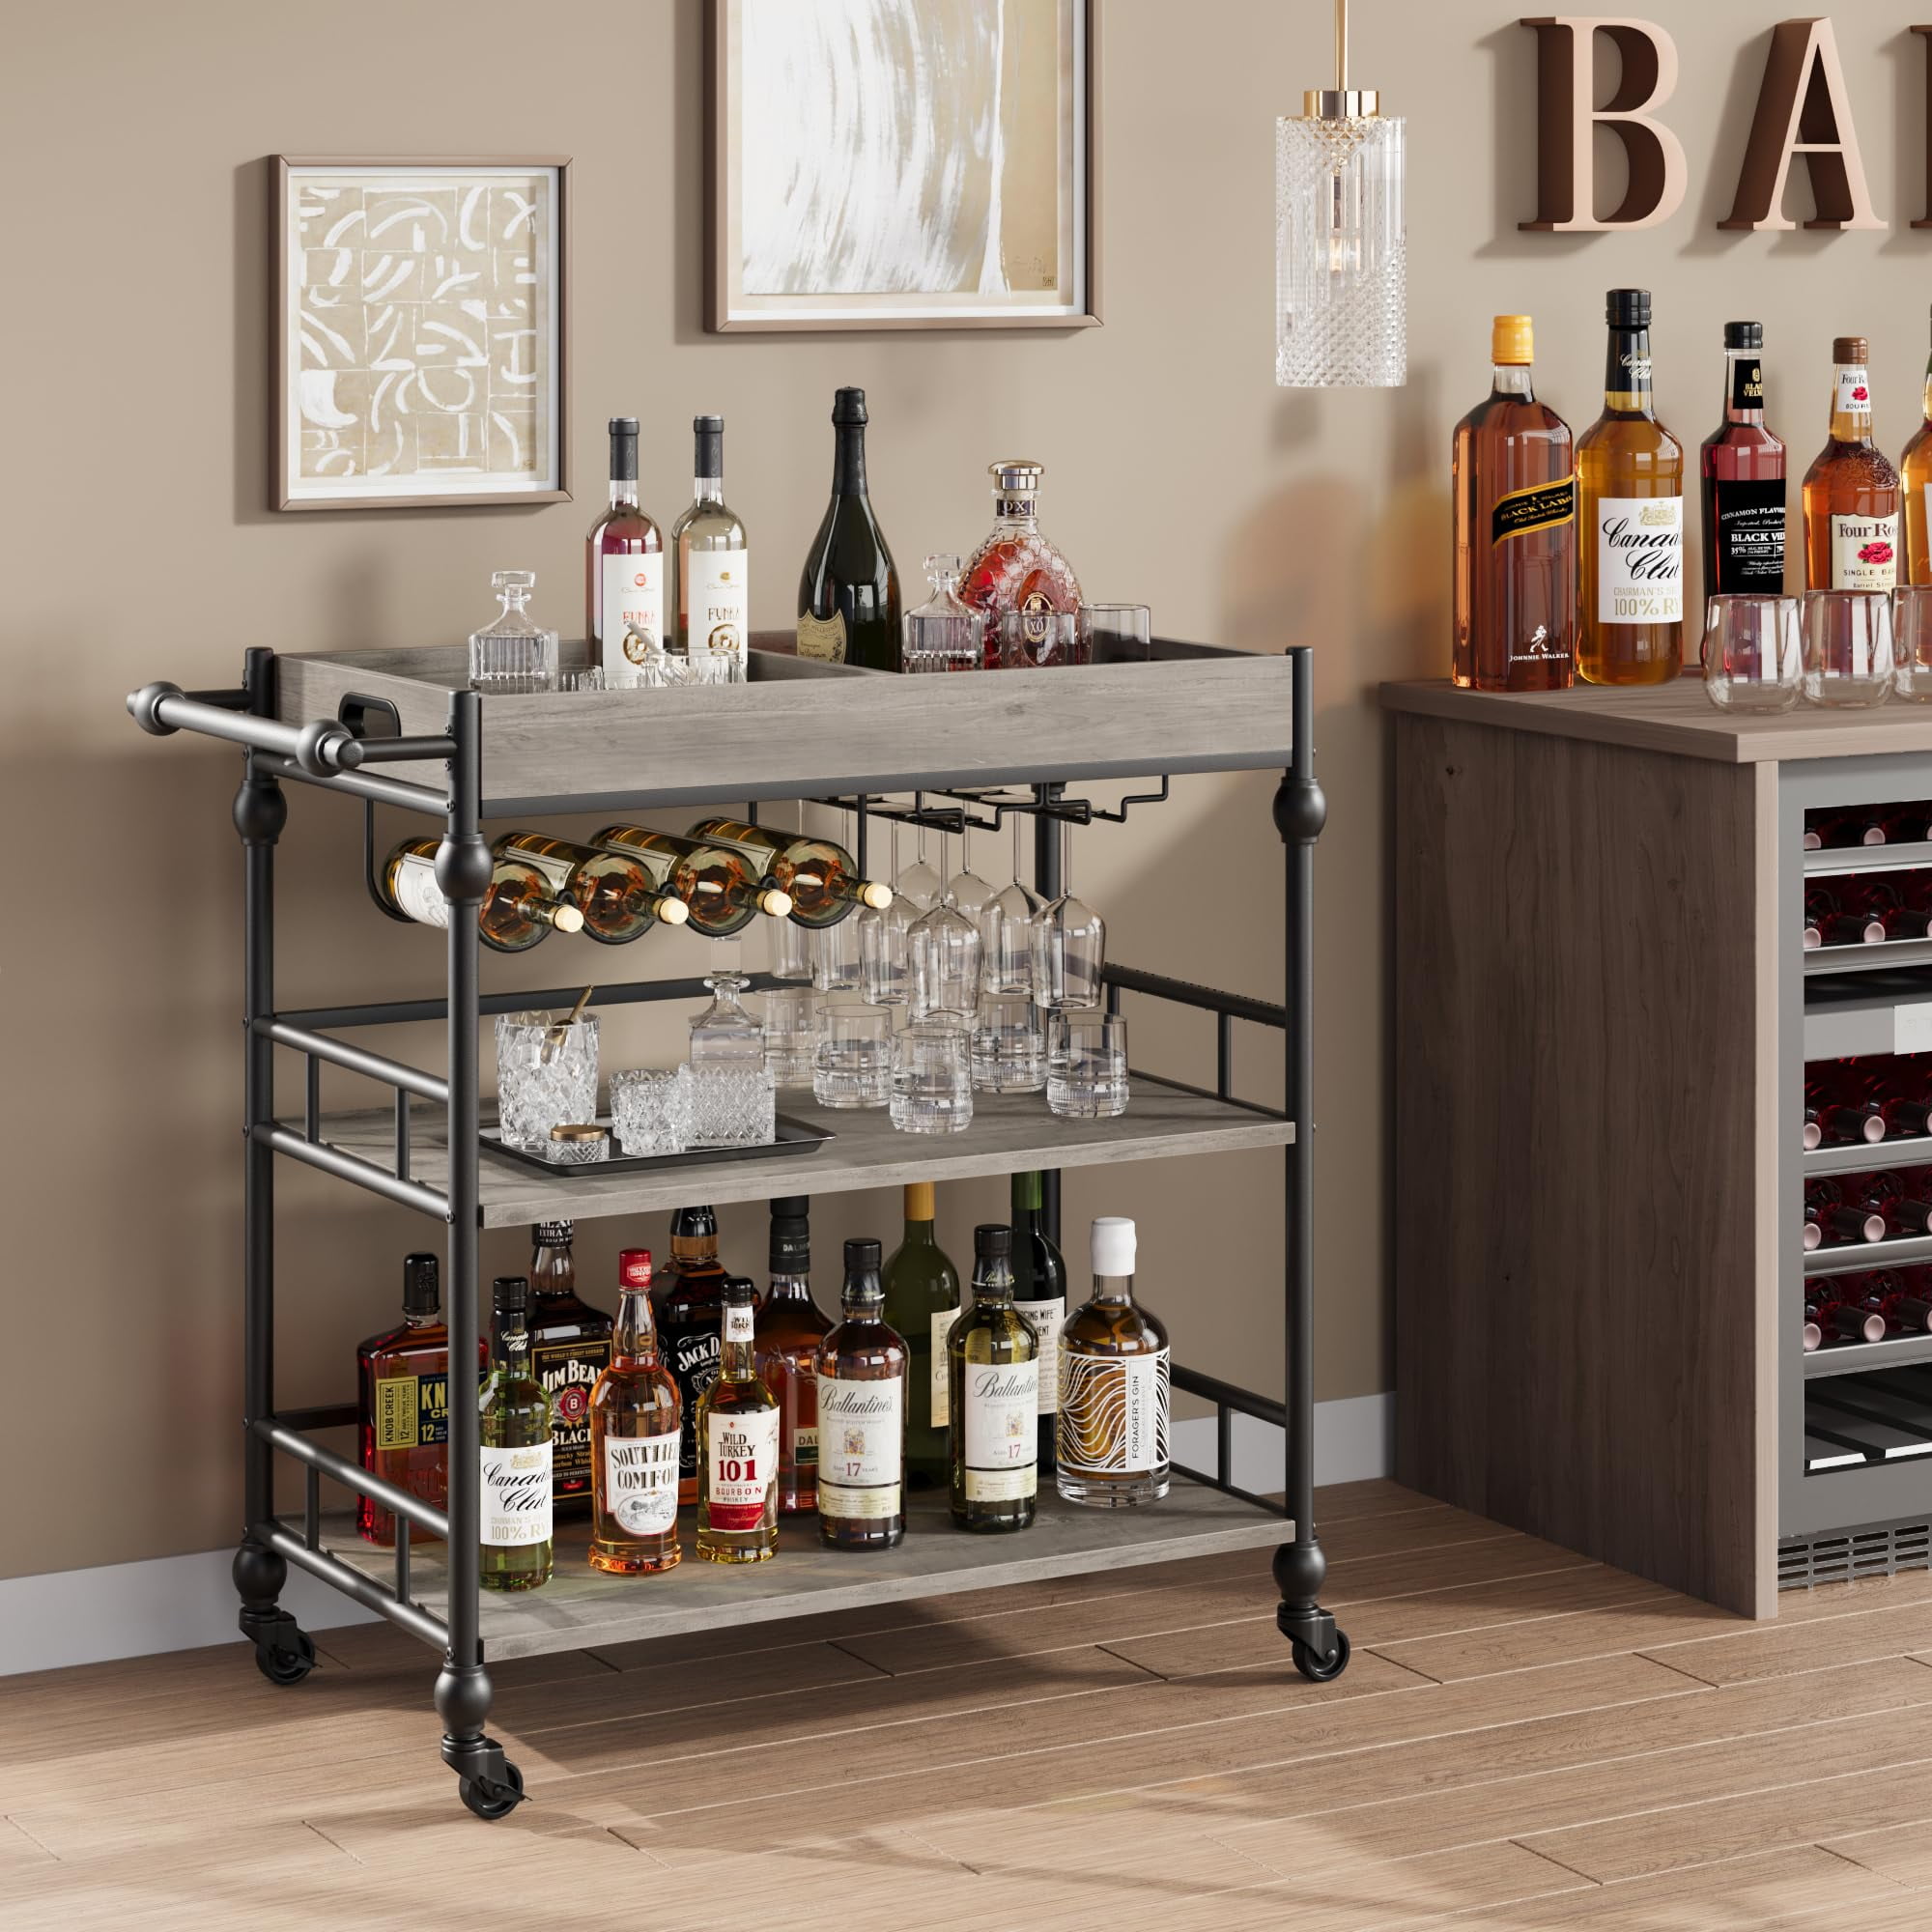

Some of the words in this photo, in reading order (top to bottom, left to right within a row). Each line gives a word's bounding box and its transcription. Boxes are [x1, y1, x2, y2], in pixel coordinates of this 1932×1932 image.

[1518, 16, 1932, 231] BA
[1500, 505, 1538, 522] BLACK
[1720, 508, 1758, 521] CINNAMON
[1731, 532, 1770, 542] BLACK
[1838, 523, 1872, 538] Four
[1731, 546, 1747, 555] 35%
[1843, 568, 1876, 577] SINGLE
[1614, 598, 1660, 616] 100%
[1508, 654, 1540, 663] JOHNNIE
[1039, 1308, 1054, 1321] WIFE
[677, 1342, 710, 1372] JACK
[542, 1367, 566, 1393] JIM
[384, 1386, 394, 1416] CREEK
[570, 1399, 577, 1409] B
[820, 1384, 894, 1414] Ballantine's
[384, 1417, 394, 1442] KNOB
[400, 1431, 410, 1440] 12
[421, 1423, 435, 1442] 12
[723, 1432, 748, 1445] WILD
[718, 1441, 756, 1458] TURKEY
[1009, 1443, 1021, 1459] 17
[718, 1459, 757, 1481] 101
[846, 1462, 861, 1477] 17
[716, 1487, 762, 1496] BOURBON
[492, 1525, 527, 1541] 100%
